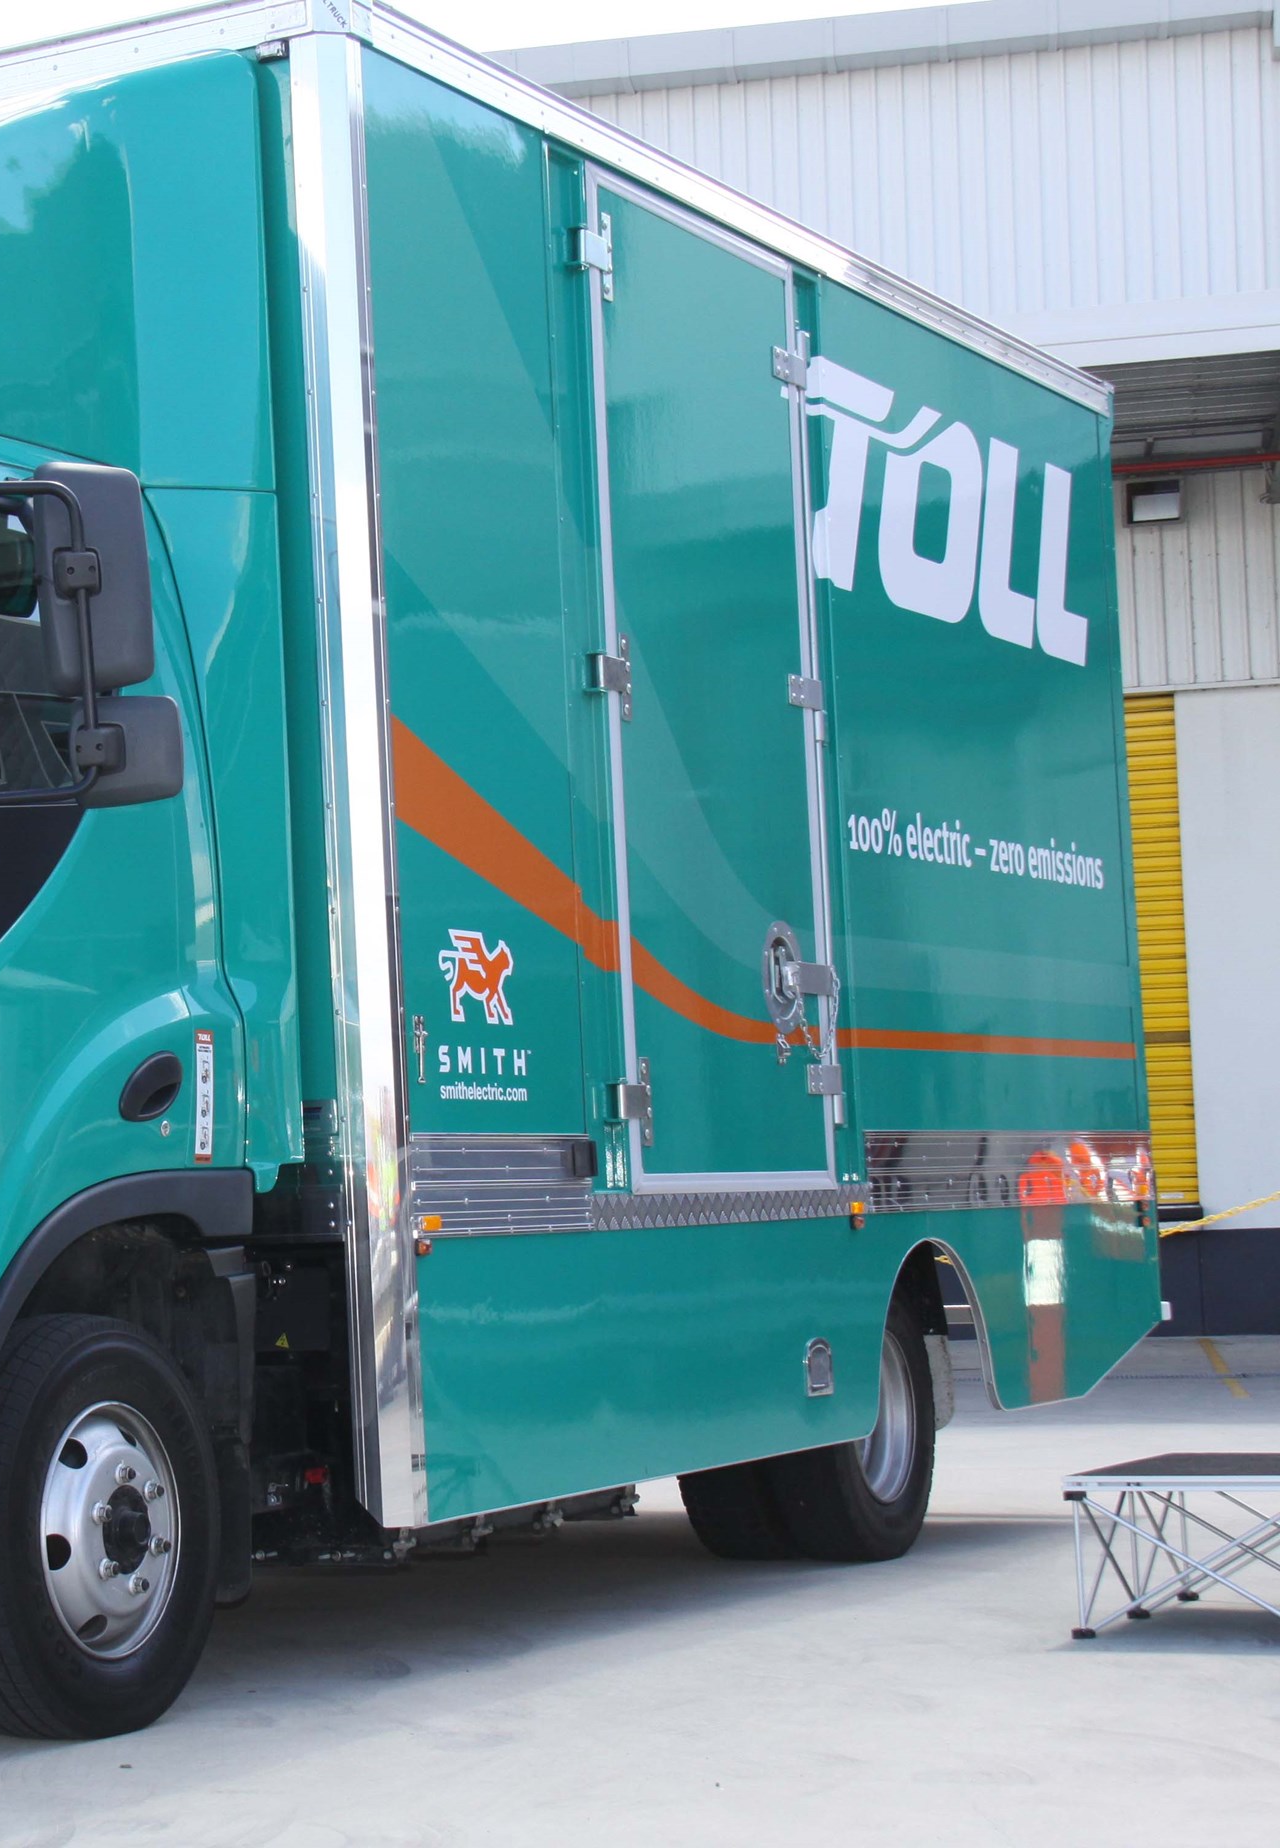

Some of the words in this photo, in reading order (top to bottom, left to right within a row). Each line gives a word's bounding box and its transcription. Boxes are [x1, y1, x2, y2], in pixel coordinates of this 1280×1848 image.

[780, 355, 1088, 667] TOLL
[847, 807, 903, 858] 100%
[905, 812, 973, 869] electric
[989, 838, 1026, 877] zero
[1028, 837, 1105, 890] emissions
[438, 1045, 527, 1077] SMITH
[440, 1081, 528, 1102] smithelectric.com
